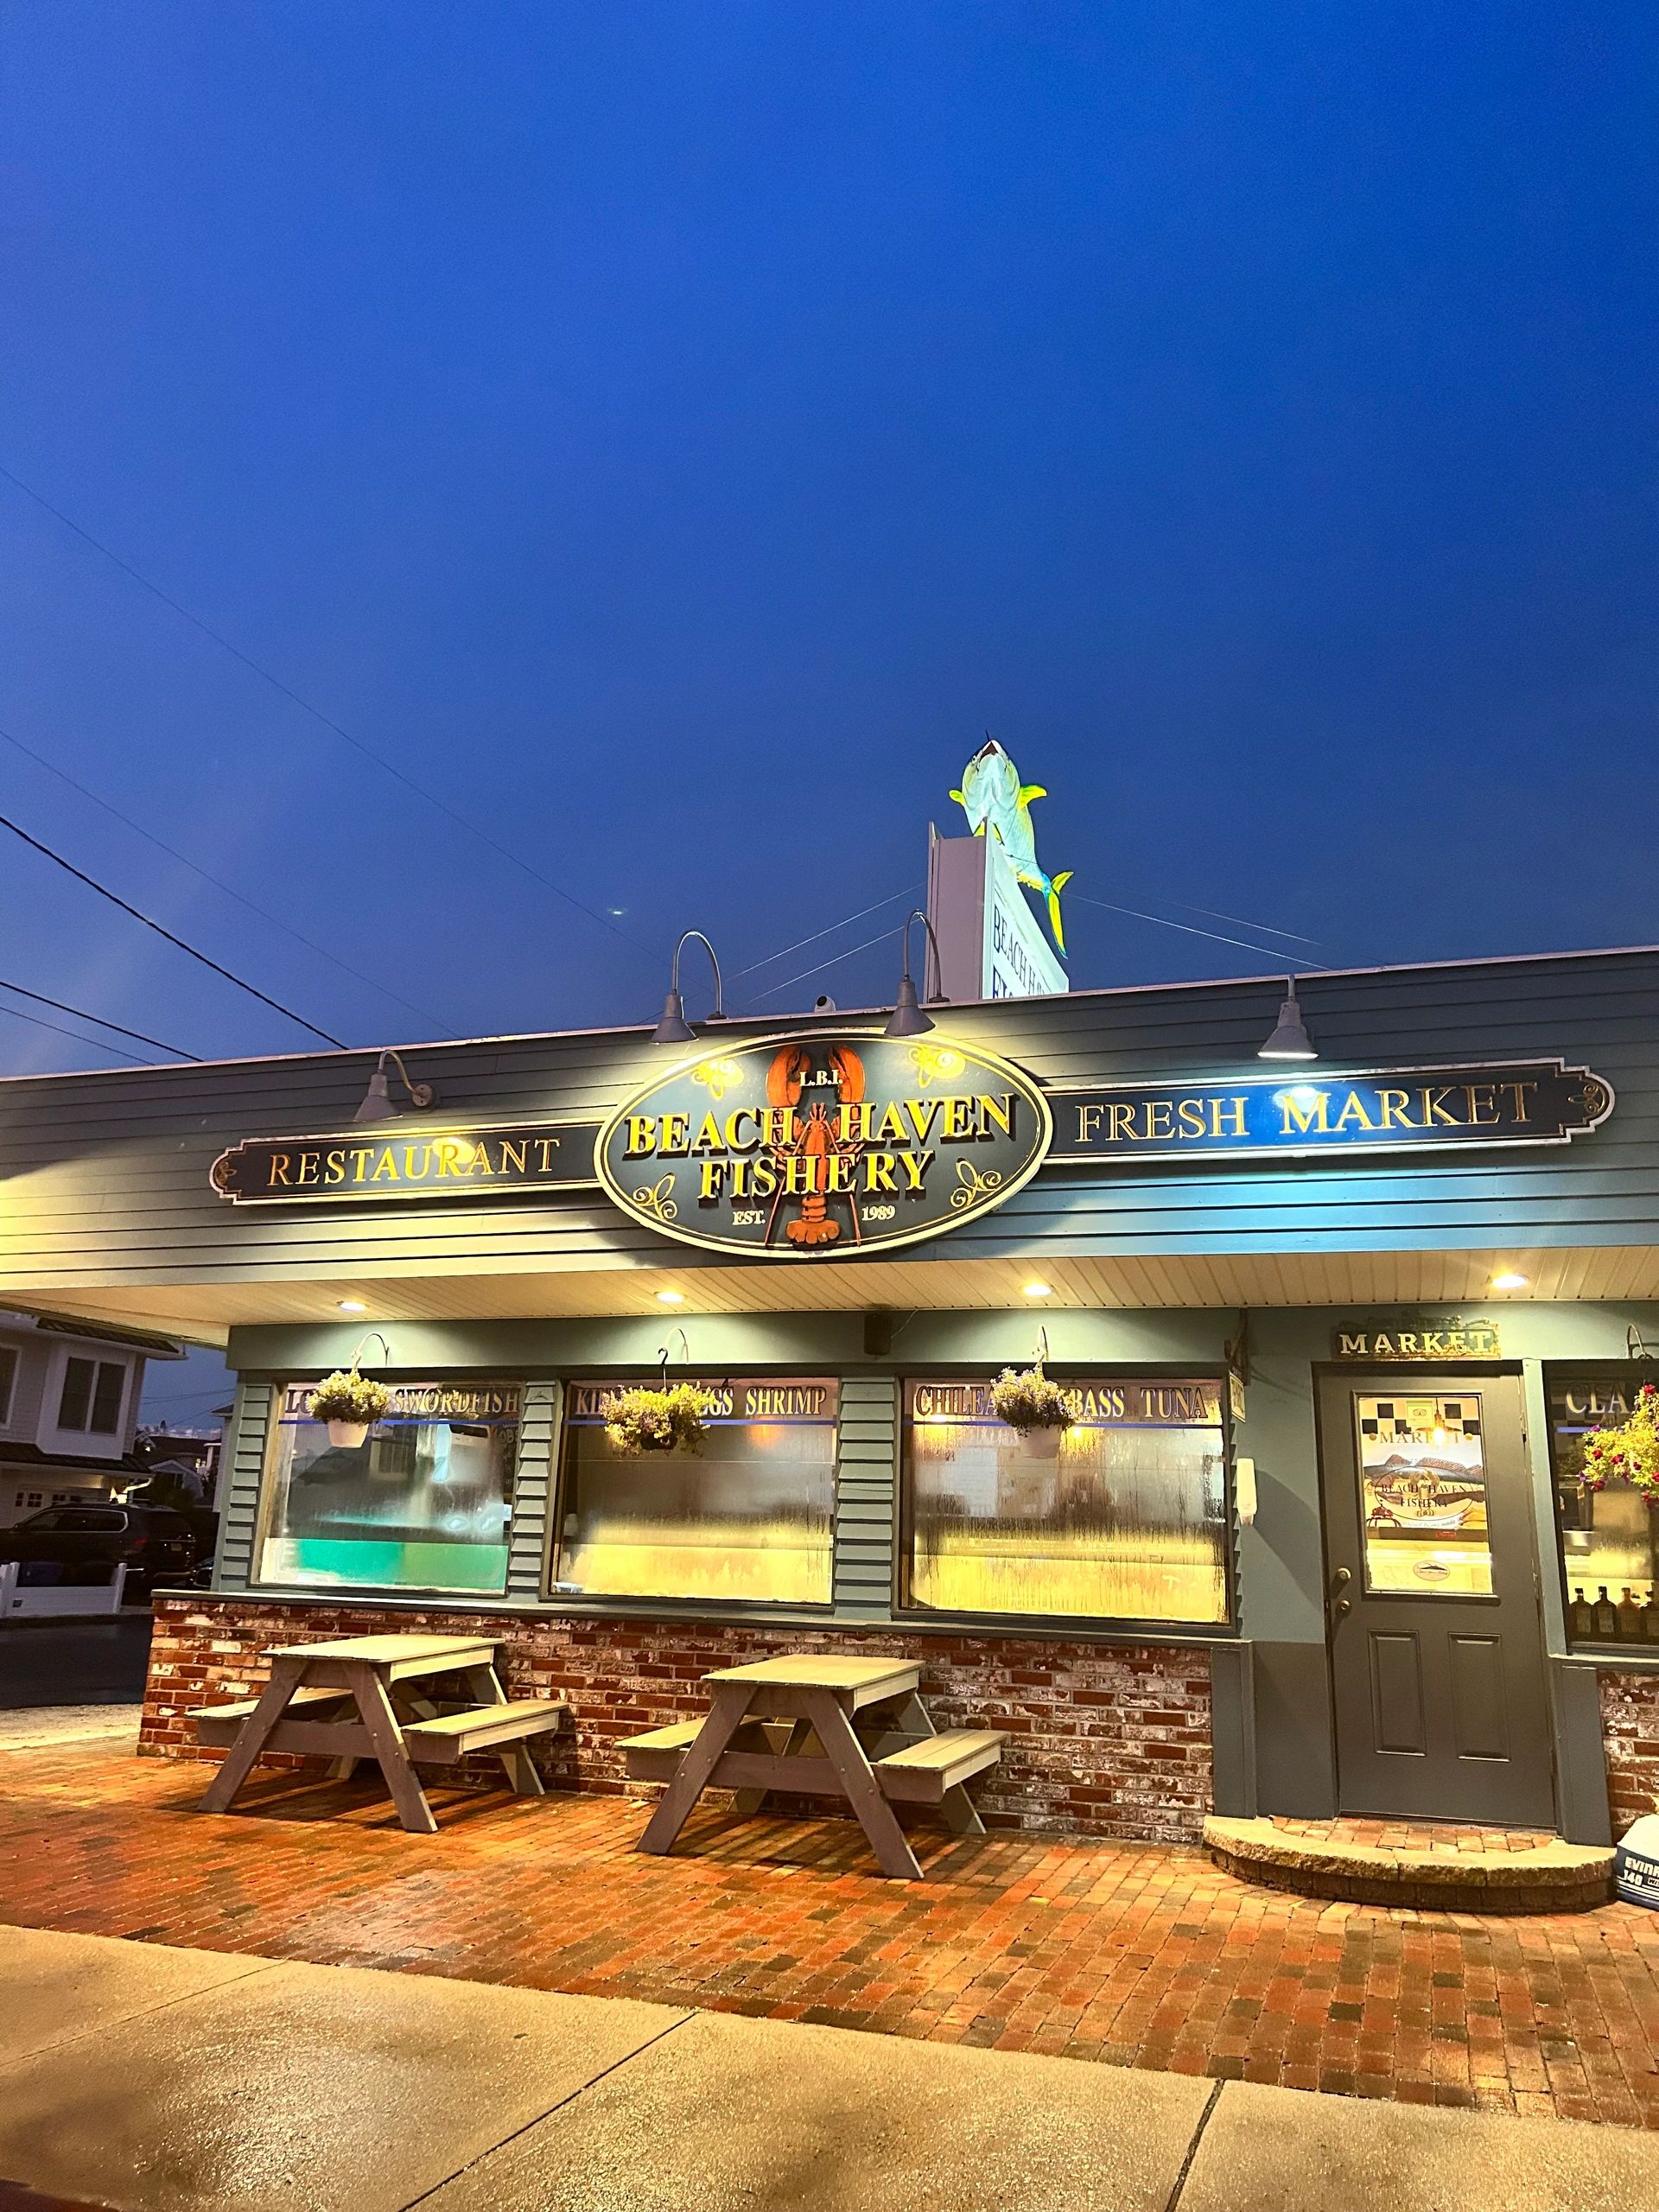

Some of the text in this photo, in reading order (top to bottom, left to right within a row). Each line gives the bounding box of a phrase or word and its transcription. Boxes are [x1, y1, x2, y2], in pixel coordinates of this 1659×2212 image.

[993, 903, 1027, 988] BEACH
[799, 1069, 843, 1087] L.B.I.
[624, 1092, 1015, 1156] BEACH HAVEN
[1074, 1081, 1538, 1143] FRESH MARKET
[266, 1139, 561, 1186] RESTAURANT
[696, 1149, 935, 1200] FISHERY
[732, 1205, 896, 1226] EST. 1989
[1339, 1332, 1491, 1354] MARKET
[394, 1388, 519, 1414] SWORDFISH
[746, 1386, 826, 1416] SHRIMP
[1067, 1386, 1125, 1419] BASS
[1141, 1387, 1209, 1419] TUNA
[1566, 1382, 1630, 1414] CLA
